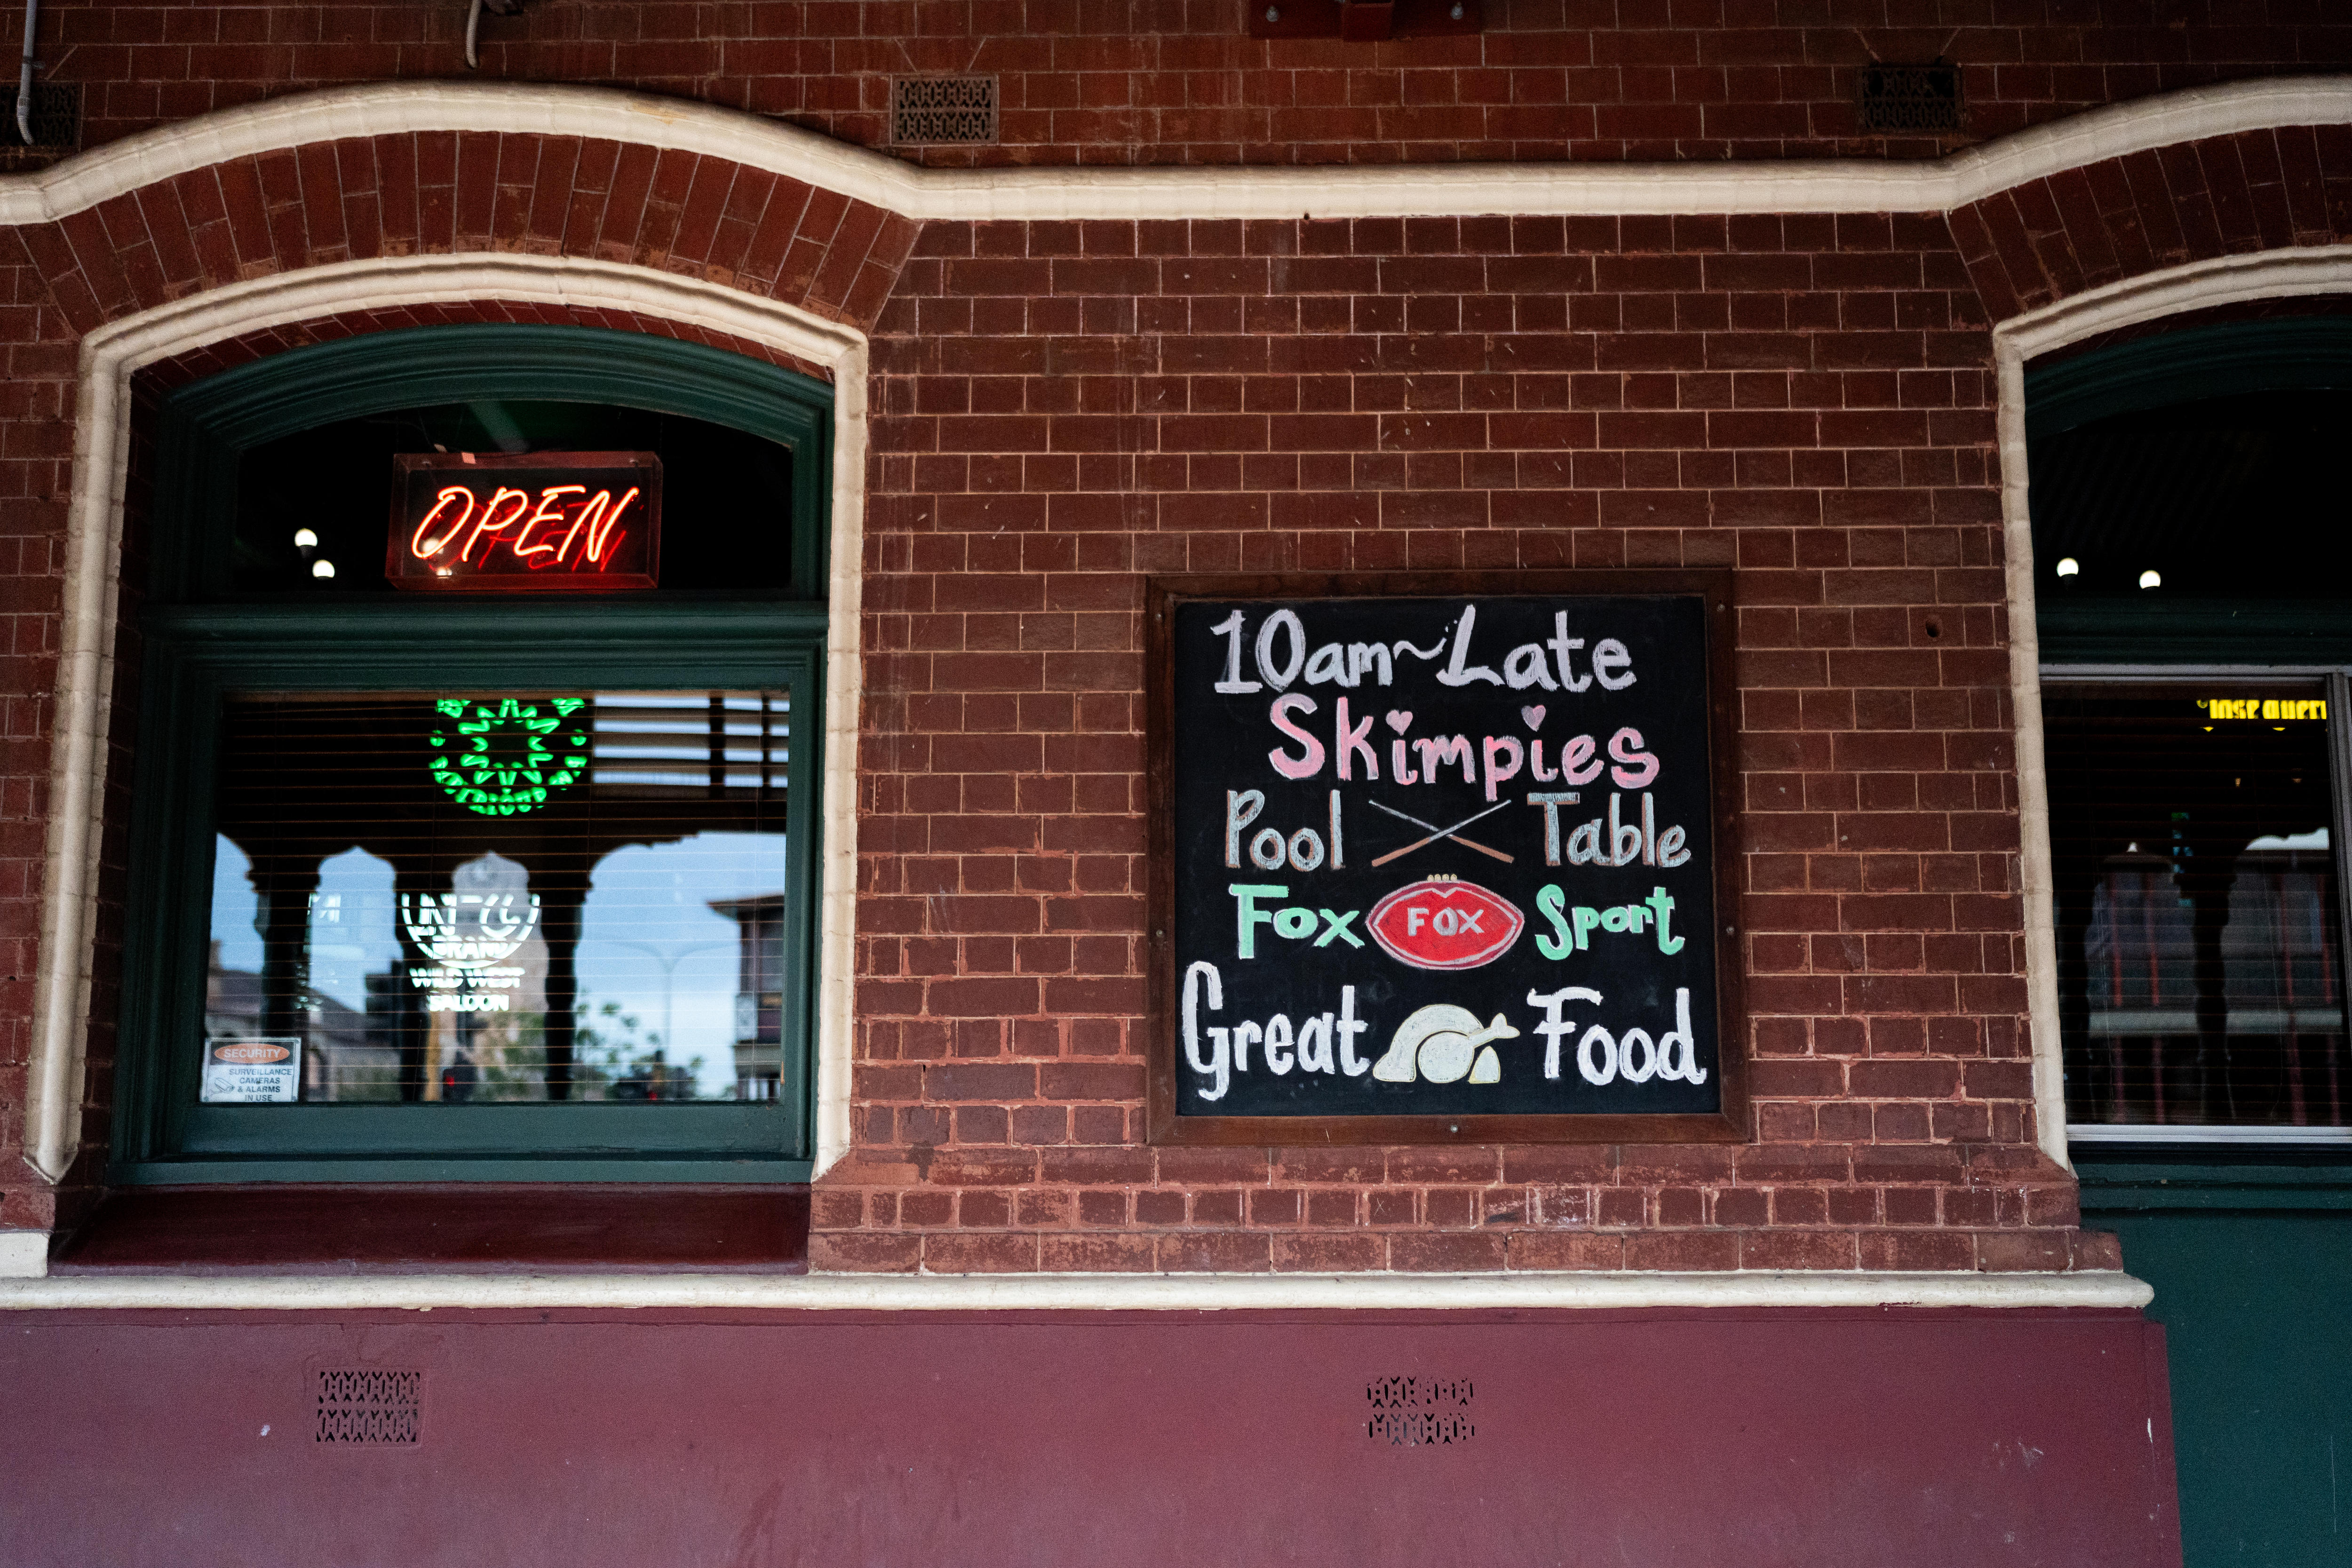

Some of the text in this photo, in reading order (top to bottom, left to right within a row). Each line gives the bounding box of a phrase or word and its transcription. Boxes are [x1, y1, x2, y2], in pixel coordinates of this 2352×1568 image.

[411, 485, 640, 563] OPEN
[1268, 693, 1660, 802] Skimpies
[1225, 789, 1692, 871] Pool Table
[1228, 883, 1685, 961] Fox Sport
[1407, 907, 1485, 937] FOX
[409, 967, 464, 988] WILD
[429, 990, 510, 1012] SALOON
[224, 1048, 281, 1059] SECURITY
[1182, 961, 1707, 1102] Great Food
